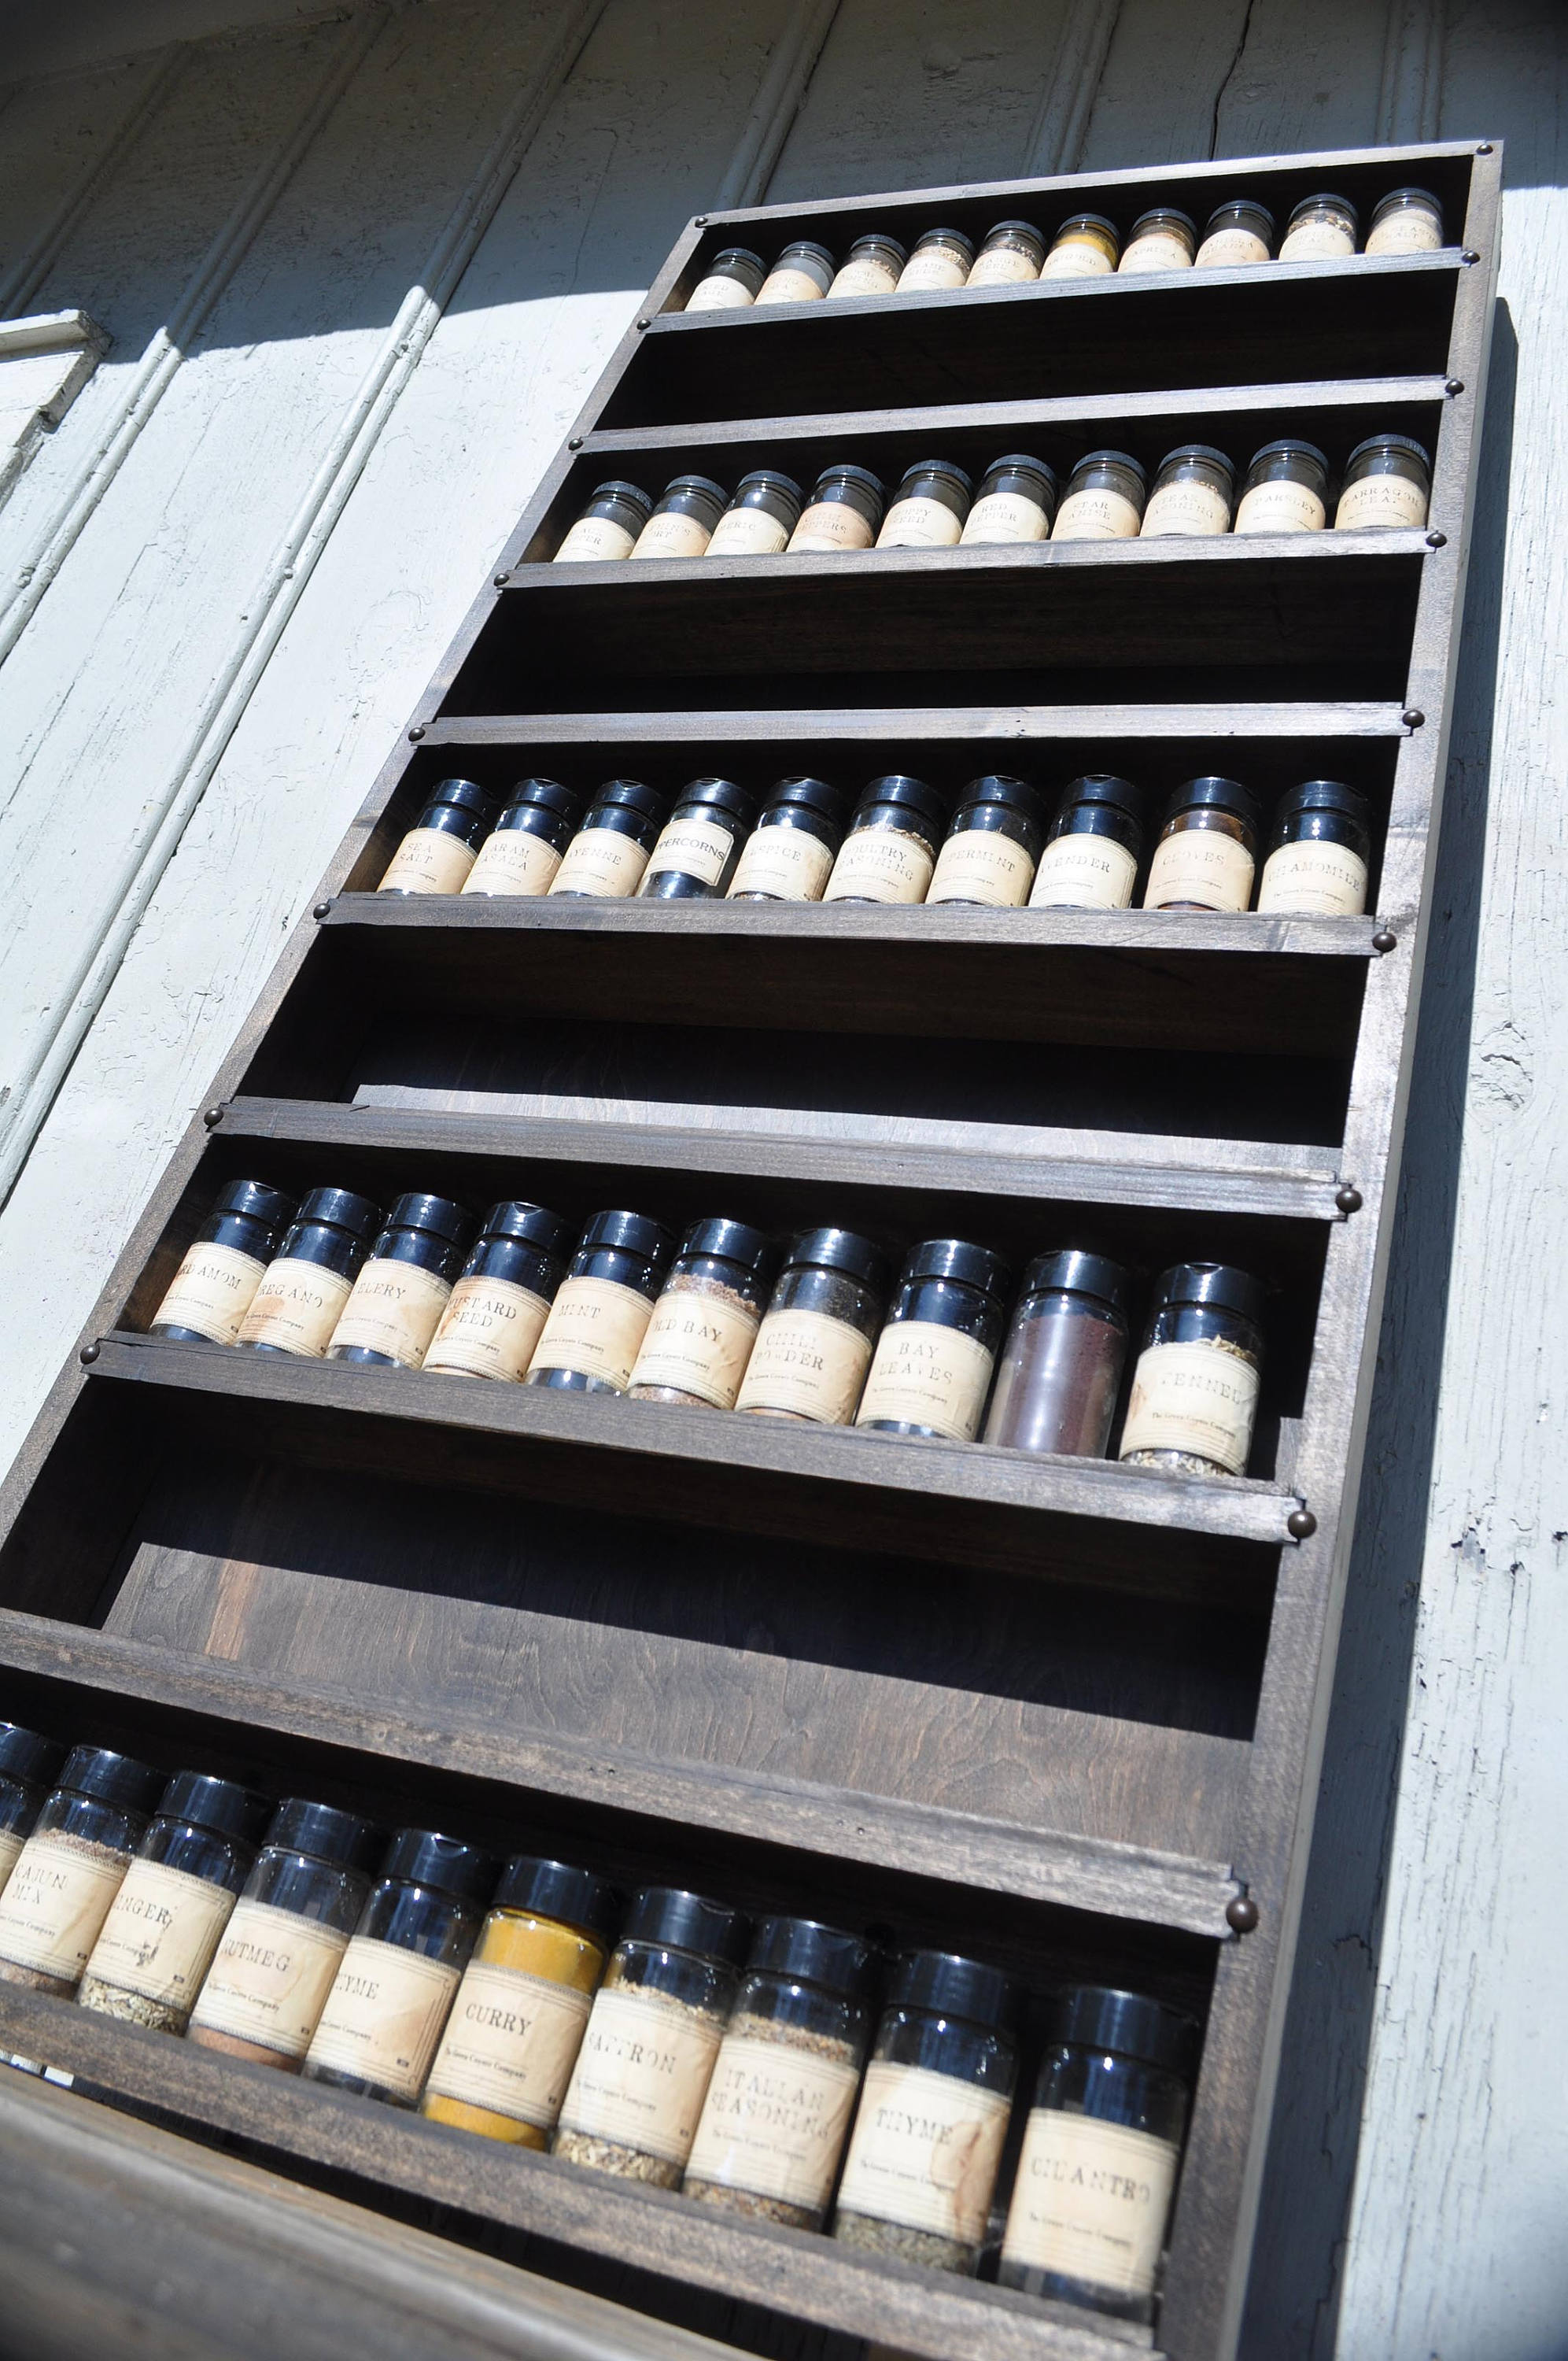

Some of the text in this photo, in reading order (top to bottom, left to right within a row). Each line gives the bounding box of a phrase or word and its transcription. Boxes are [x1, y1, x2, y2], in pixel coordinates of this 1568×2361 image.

[177, 1263, 242, 1291] RDAMOM
[258, 1284, 323, 1308] REGANO
[356, 1282, 406, 1299] ELERY
[754, 1349, 825, 1371] PODER
[898, 1341, 940, 1359] BAY
[465, 2001, 532, 2037] CURRY
